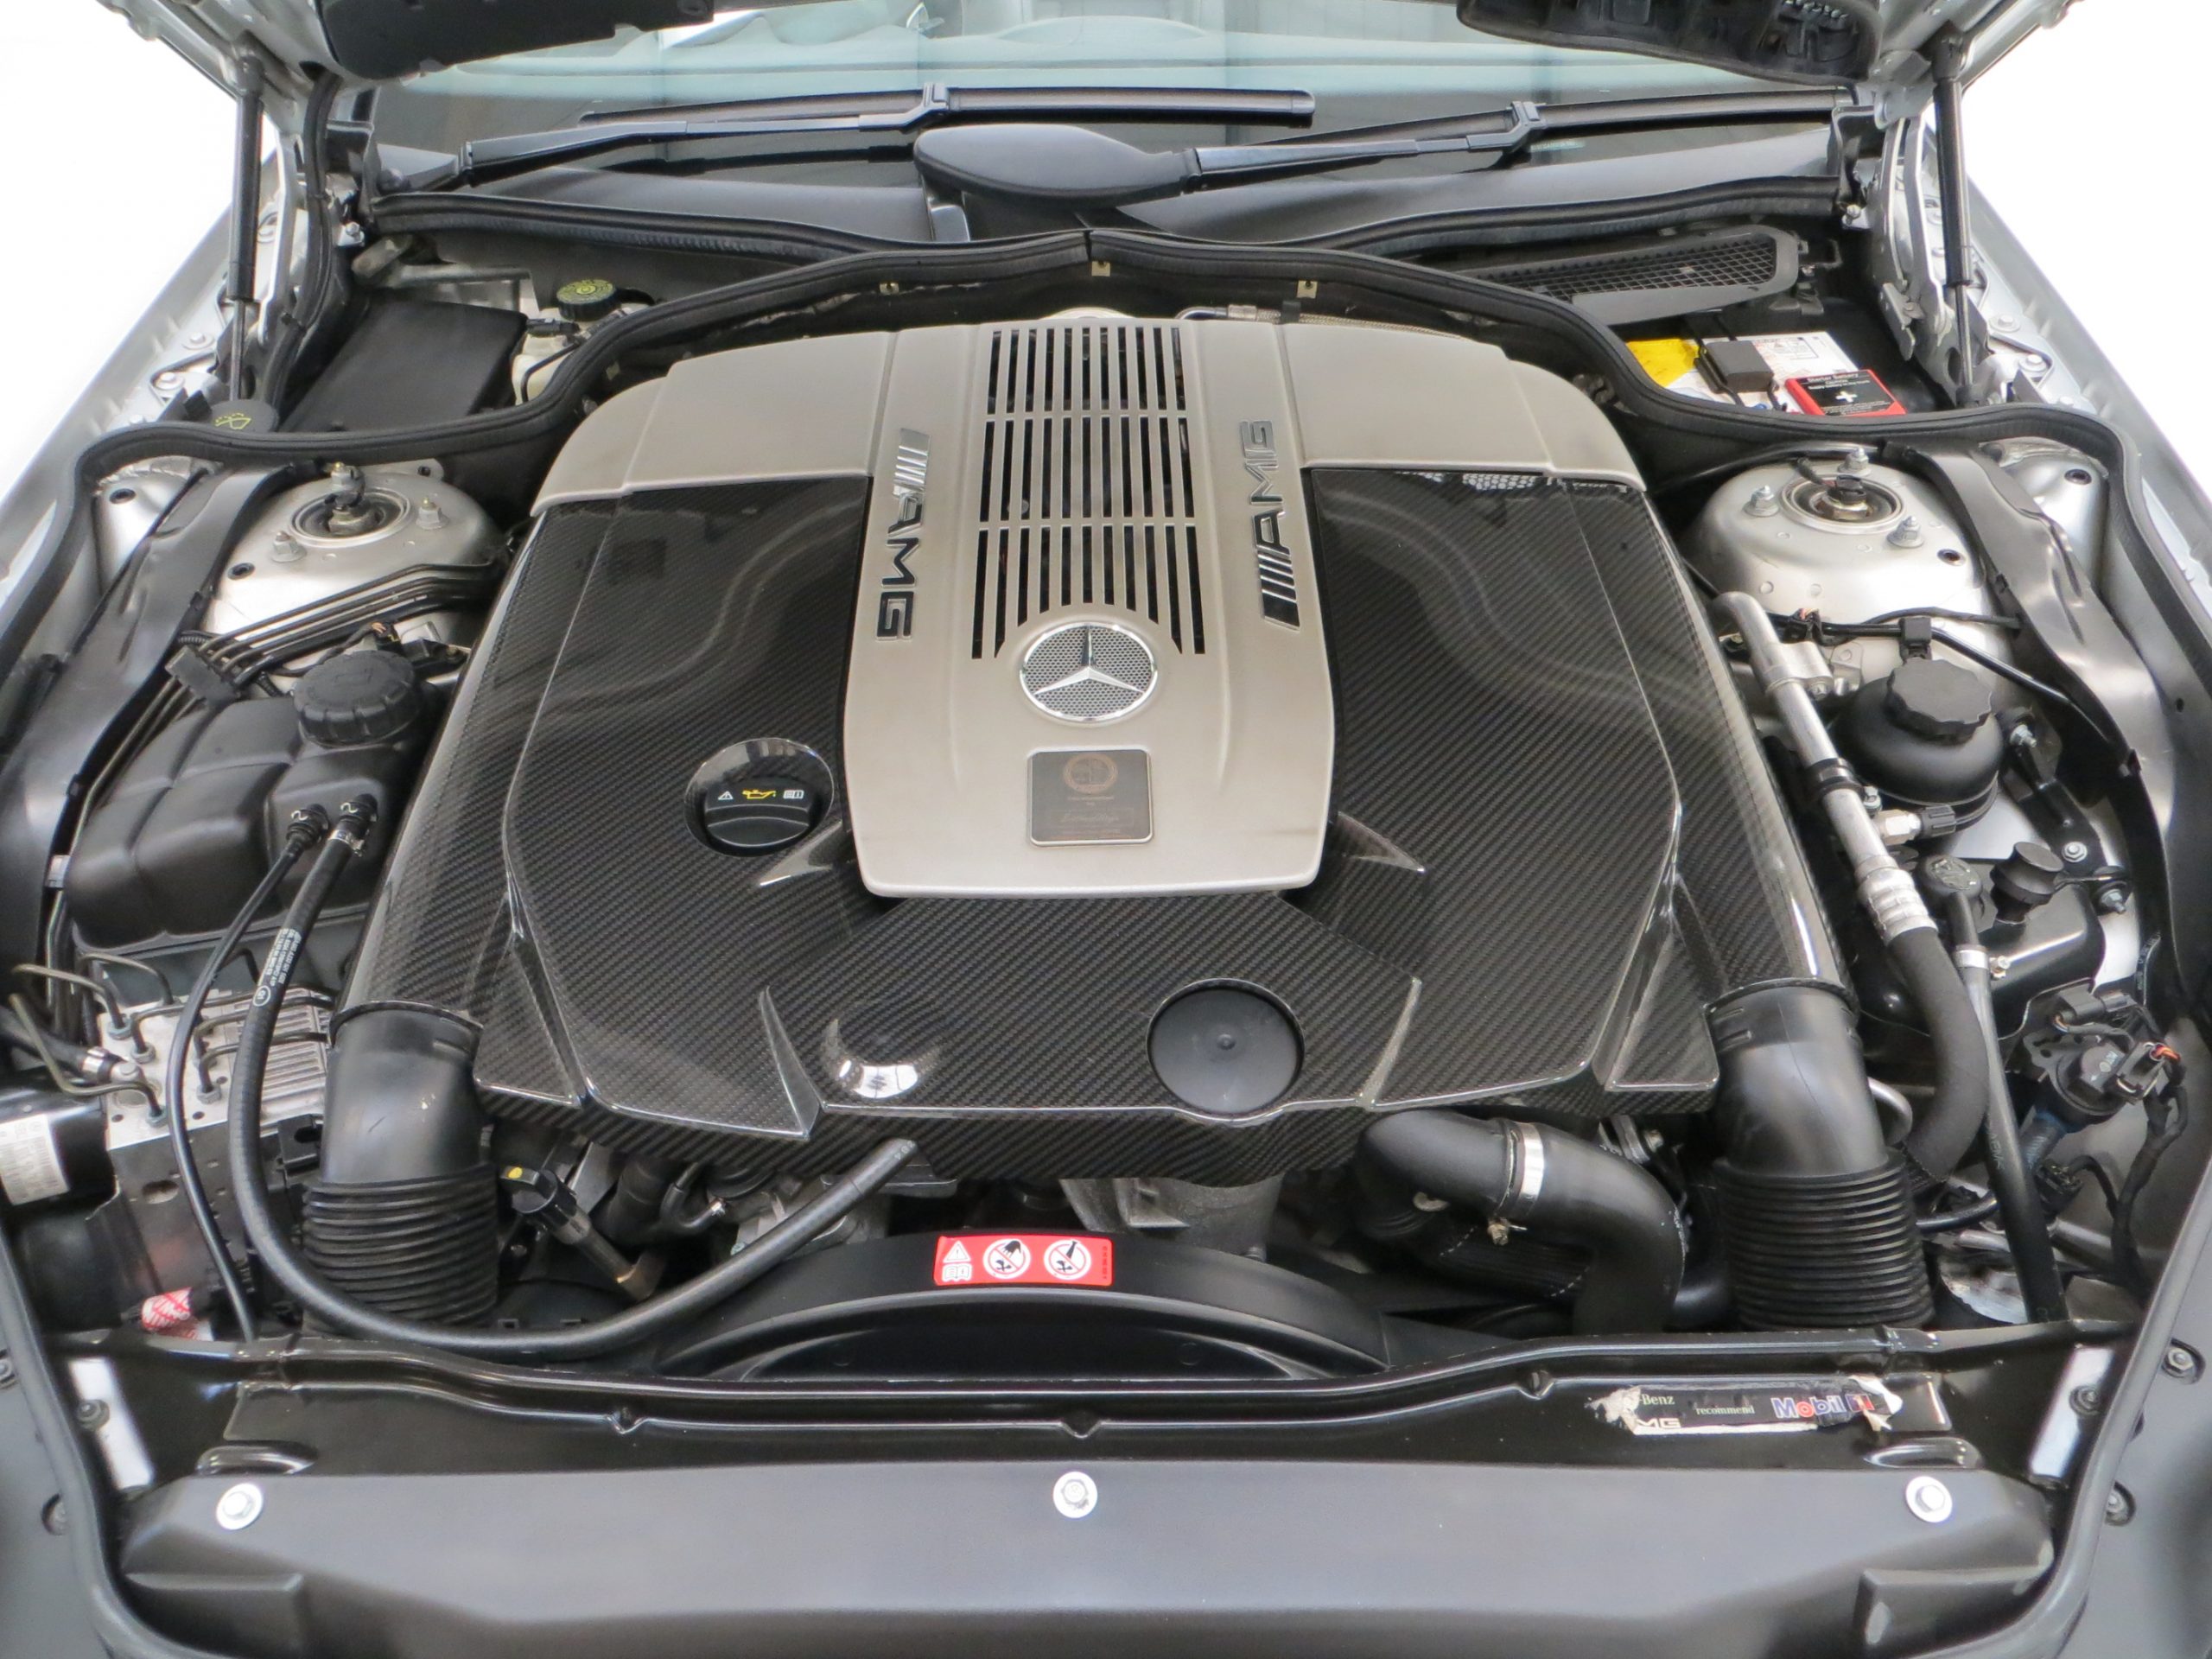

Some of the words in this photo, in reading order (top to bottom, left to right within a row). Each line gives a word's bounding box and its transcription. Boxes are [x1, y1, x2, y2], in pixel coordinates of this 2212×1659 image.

[1239, 420, 1293, 566] AMG
[876, 484, 925, 641] AMG
[1636, 1417, 1681, 1429] MG
[1695, 1404, 1756, 1415] recommend
[1770, 1395, 1847, 1418] Mobil
